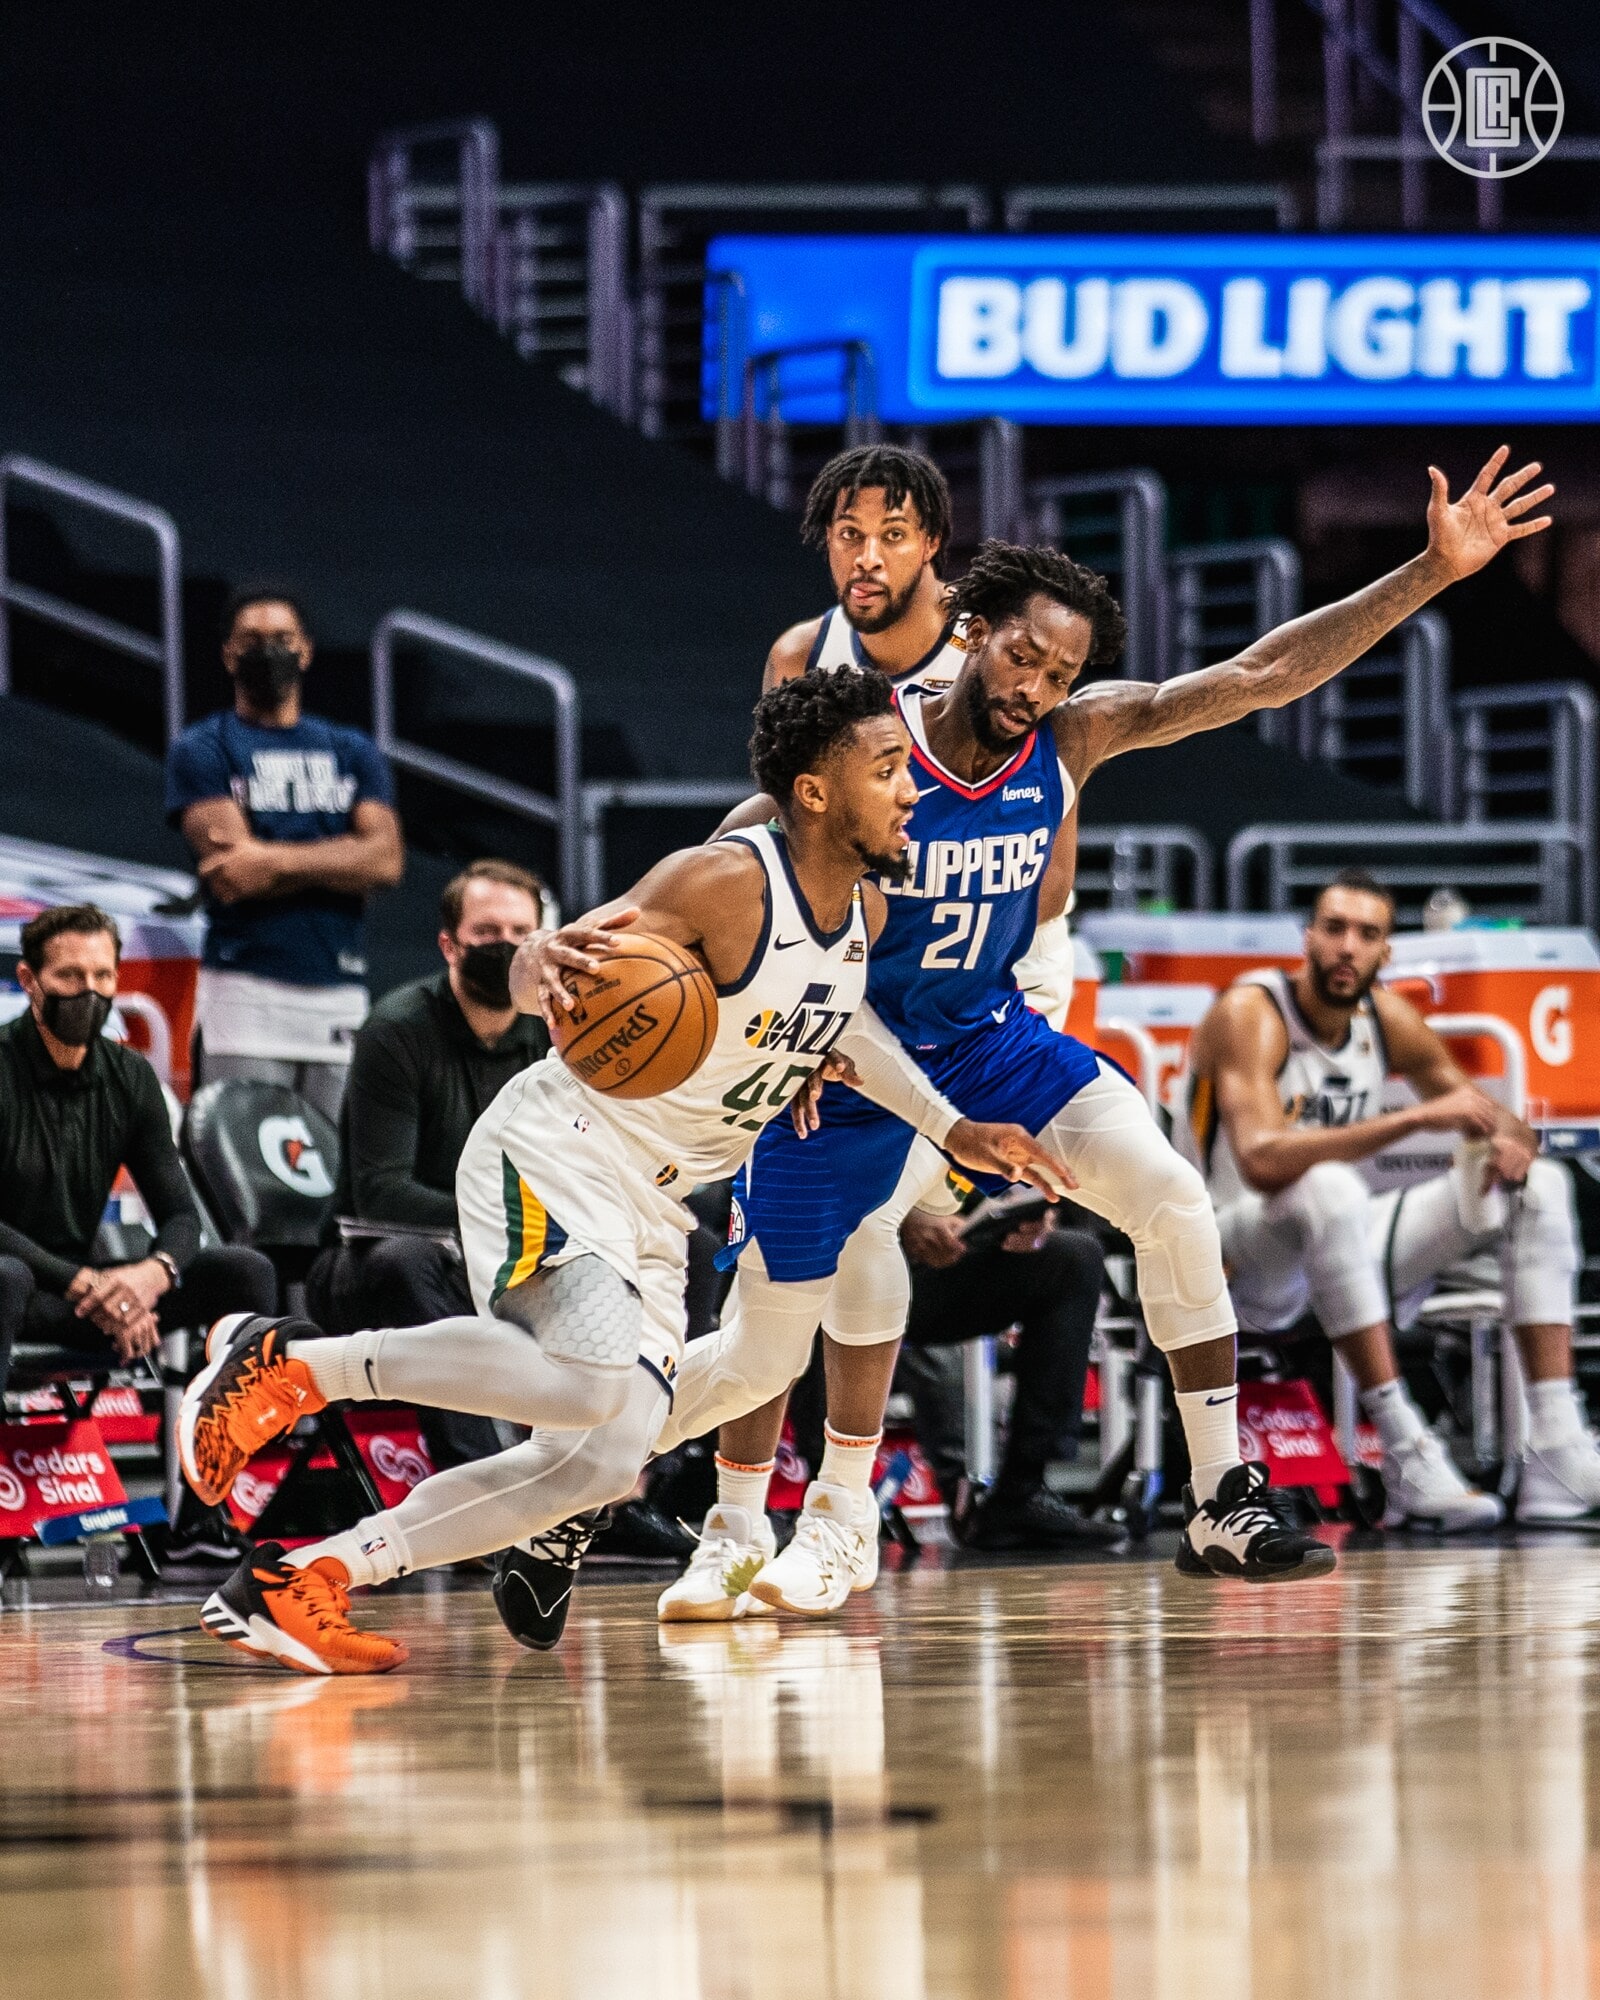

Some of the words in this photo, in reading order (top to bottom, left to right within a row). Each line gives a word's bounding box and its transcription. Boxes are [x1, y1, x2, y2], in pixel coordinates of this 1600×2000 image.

[937, 277, 1208, 379] BUD
[1219, 277, 1591, 380] LIGHT
[1003, 785, 1044, 803] honey
[921, 902, 993, 970] 21
[572, 1003, 659, 1080] SPALDIN
[1530, 984, 1574, 1067] G
[258, 1115, 336, 1197] G
[14, 1447, 106, 1477] Cedars
[37, 1475, 104, 1505] Sinai
